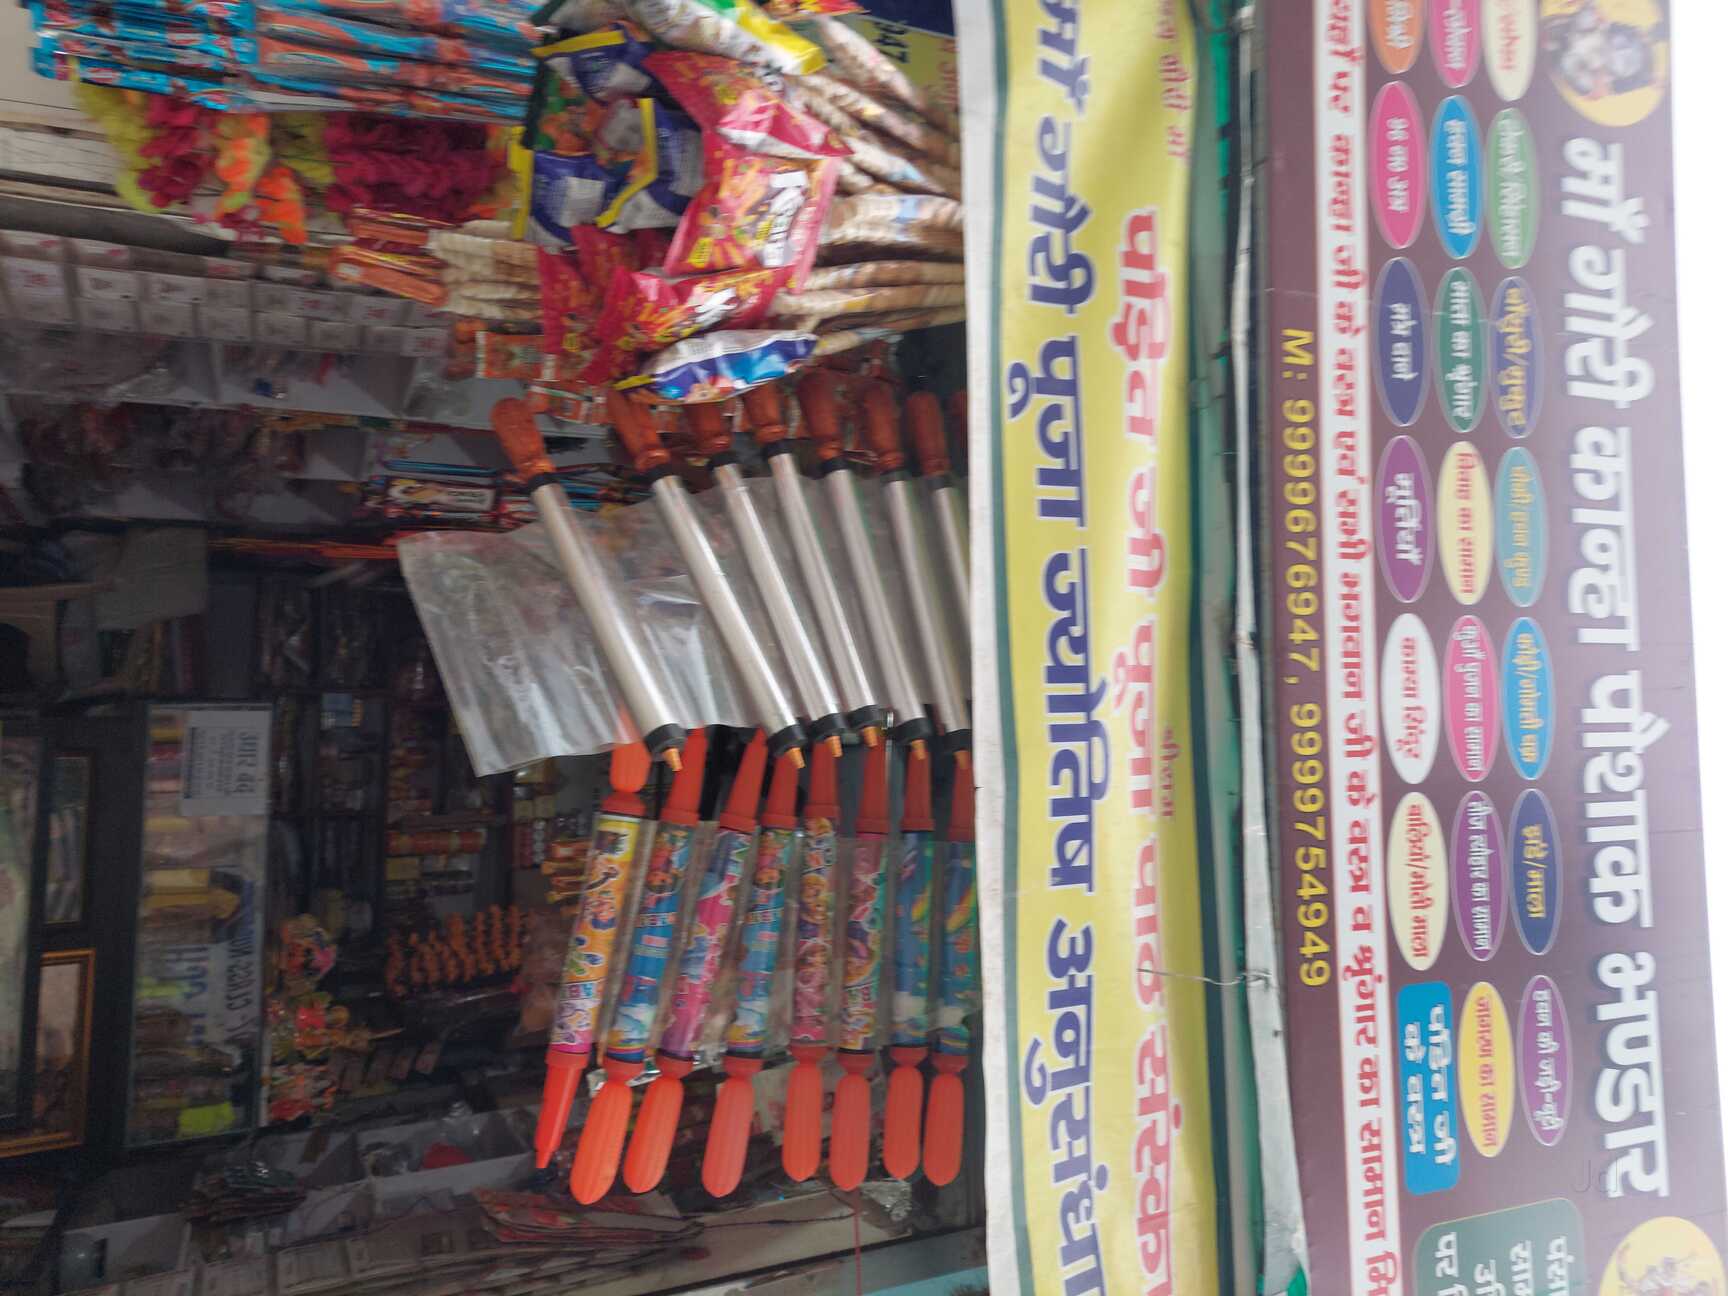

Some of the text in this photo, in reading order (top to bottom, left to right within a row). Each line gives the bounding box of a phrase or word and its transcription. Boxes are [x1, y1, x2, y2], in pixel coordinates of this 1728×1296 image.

[1029, 117, 1096, 313] गौरी
[1332, 245, 1366, 290] जी
[1281, 329, 1314, 380] M:
[1334, 302, 1364, 336] के
[1008, 338, 1088, 527] पूजा
[1128, 472, 1167, 597] जी
[1339, 572, 1367, 701] भगवान
[1561, 138, 1671, 1198] माँ गौरी कान्हा पौशाक भण्डार
[1044, 548, 1110, 893] ज्योतिष
[1114, 621, 1157, 815] पूजा
[1342, 712, 1376, 759] जी
[1288, 703, 1330, 987] 9999754949
[1346, 771, 1377, 808] के
[1134, 841, 1165, 1009] पाठ
[1350, 906, 1374, 932] व
[1358, 1058, 1383, 1107] का
[1433, 1111, 1458, 1166] जी
[1360, 1120, 1389, 1240] सामान
[1433, 1232, 1459, 1277] पर
